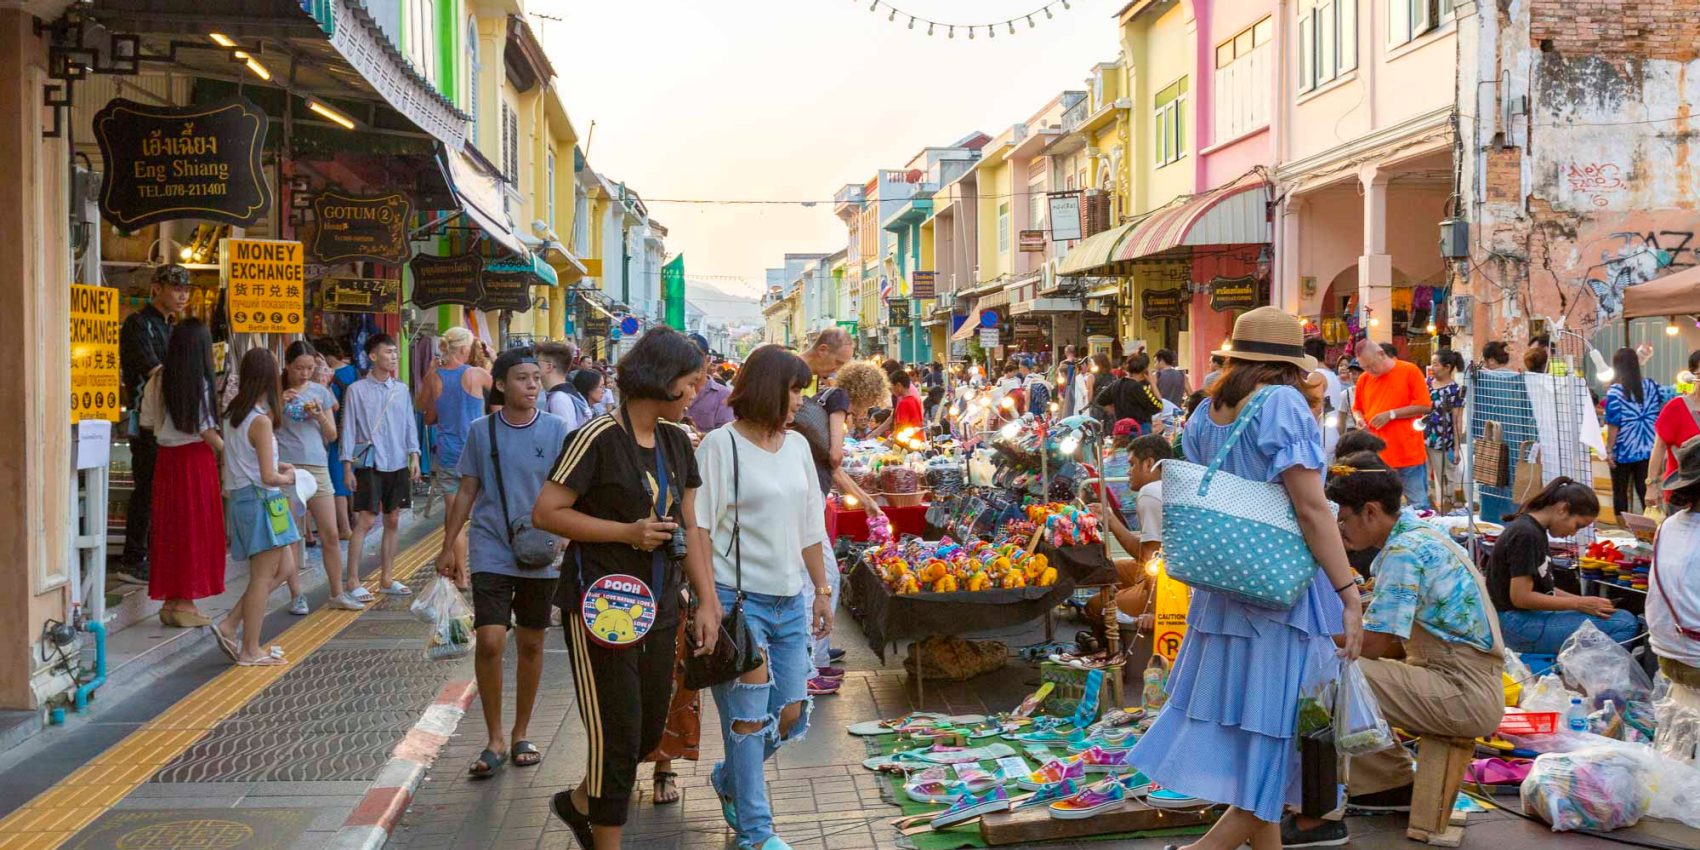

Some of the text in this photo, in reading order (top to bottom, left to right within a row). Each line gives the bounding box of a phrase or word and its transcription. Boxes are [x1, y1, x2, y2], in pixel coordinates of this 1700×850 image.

[135, 160, 229, 182] Eng Shiang
[324, 206, 376, 220] GOTUM
[237, 243, 296, 262] MONEY
[232, 263, 302, 280] EXCHANGE
[235, 283, 300, 298] 货币兑换
[70, 288, 113, 314] MONEY
[604, 580, 641, 594] POOH
